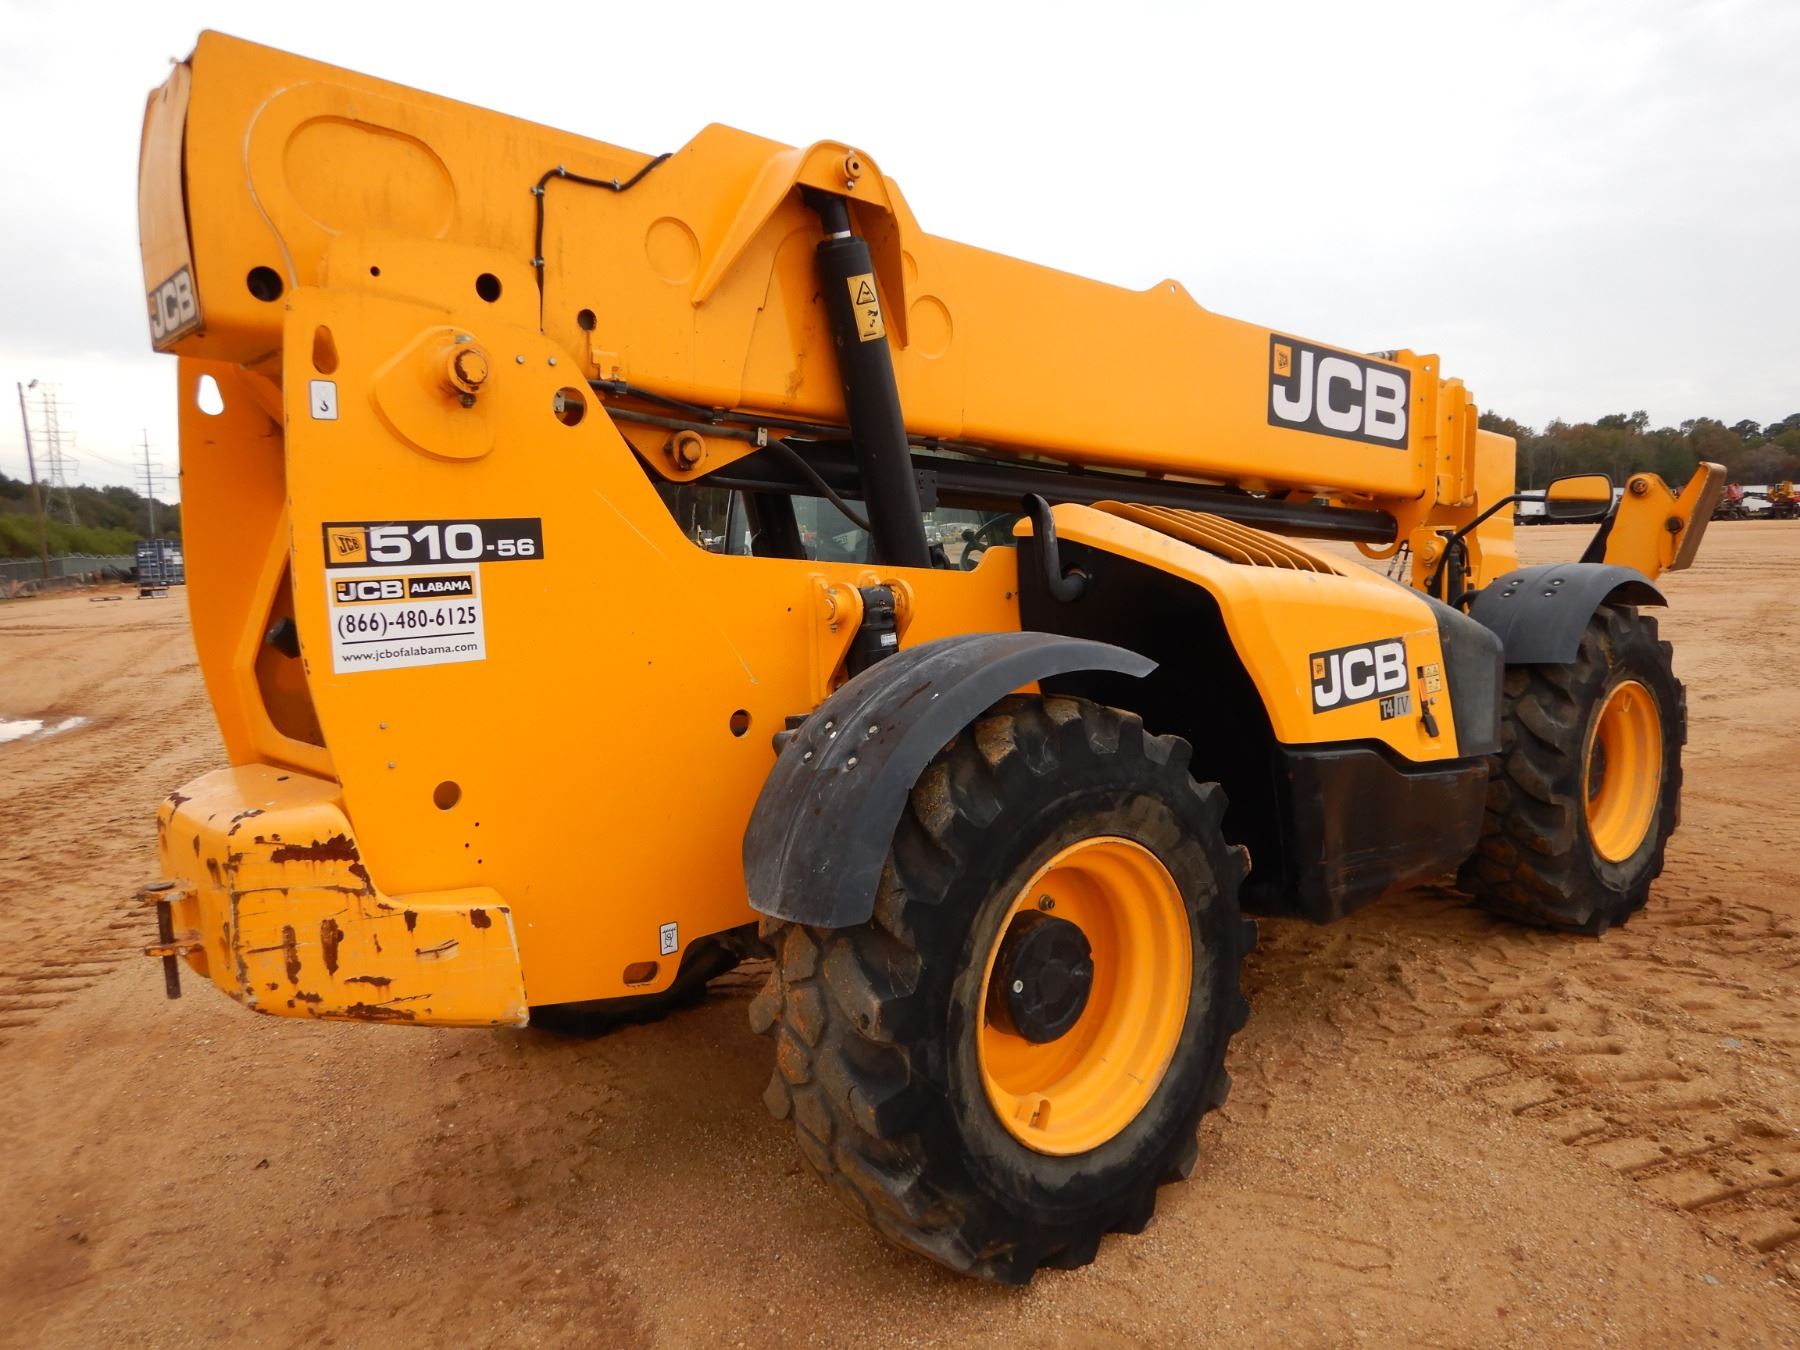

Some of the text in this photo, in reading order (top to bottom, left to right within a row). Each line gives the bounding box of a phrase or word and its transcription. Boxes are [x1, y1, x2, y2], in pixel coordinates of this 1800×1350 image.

[151, 271, 196, 339] JCB
[1273, 350, 1407, 441] JCB
[337, 580, 471, 601] JCB ALABAMA
[337, 606, 477, 639] (866)-480-6125
[342, 643, 478, 663] www.jcbofalabama.com
[1314, 642, 1407, 707] JCB
